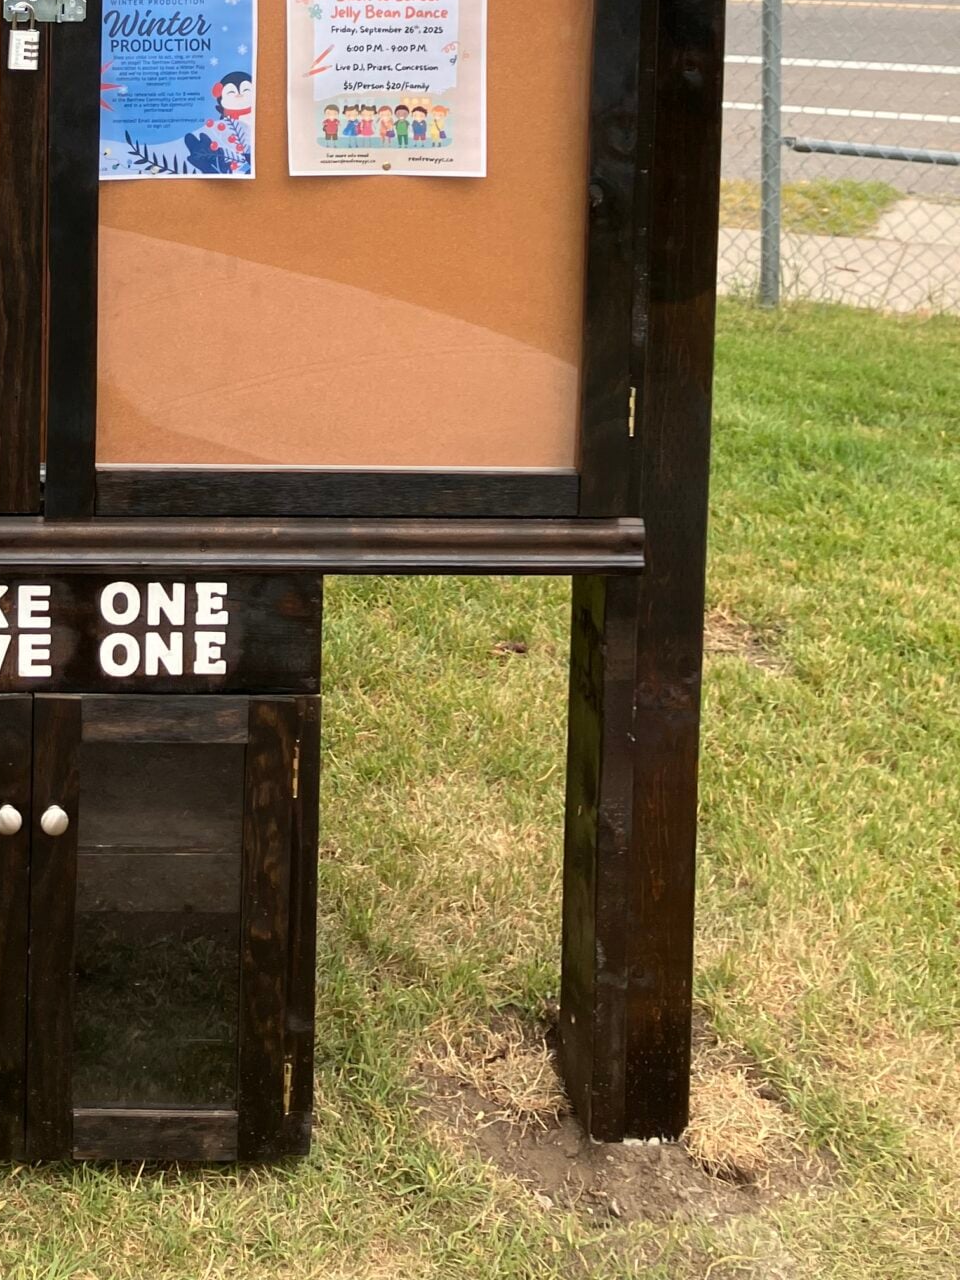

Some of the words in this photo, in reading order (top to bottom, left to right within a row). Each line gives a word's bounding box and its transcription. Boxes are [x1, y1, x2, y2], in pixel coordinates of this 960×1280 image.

[330, 5, 361, 23] Jelly
[365, 4, 401, 19] Bean
[405, 6, 449, 20] Dance
[103, 9, 212, 38] Winter
[331, 25, 358, 36] Friday,
[360, 25, 403, 36] September
[423, 26, 445, 34] 2025
[110, 38, 212, 53] PRODUCTION
[346, 44, 365, 53] 6:00
[391, 44, 409, 53] 9:00
[335, 63, 351, 71] Live
[367, 63, 393, 72] Prizes,
[395, 62, 439, 71] Concession
[343, 80, 384, 91] $5/Person
[386, 80, 431, 92] $20/Family
[100, 581, 229, 626] ONE
[99, 631, 227, 677] ONE
